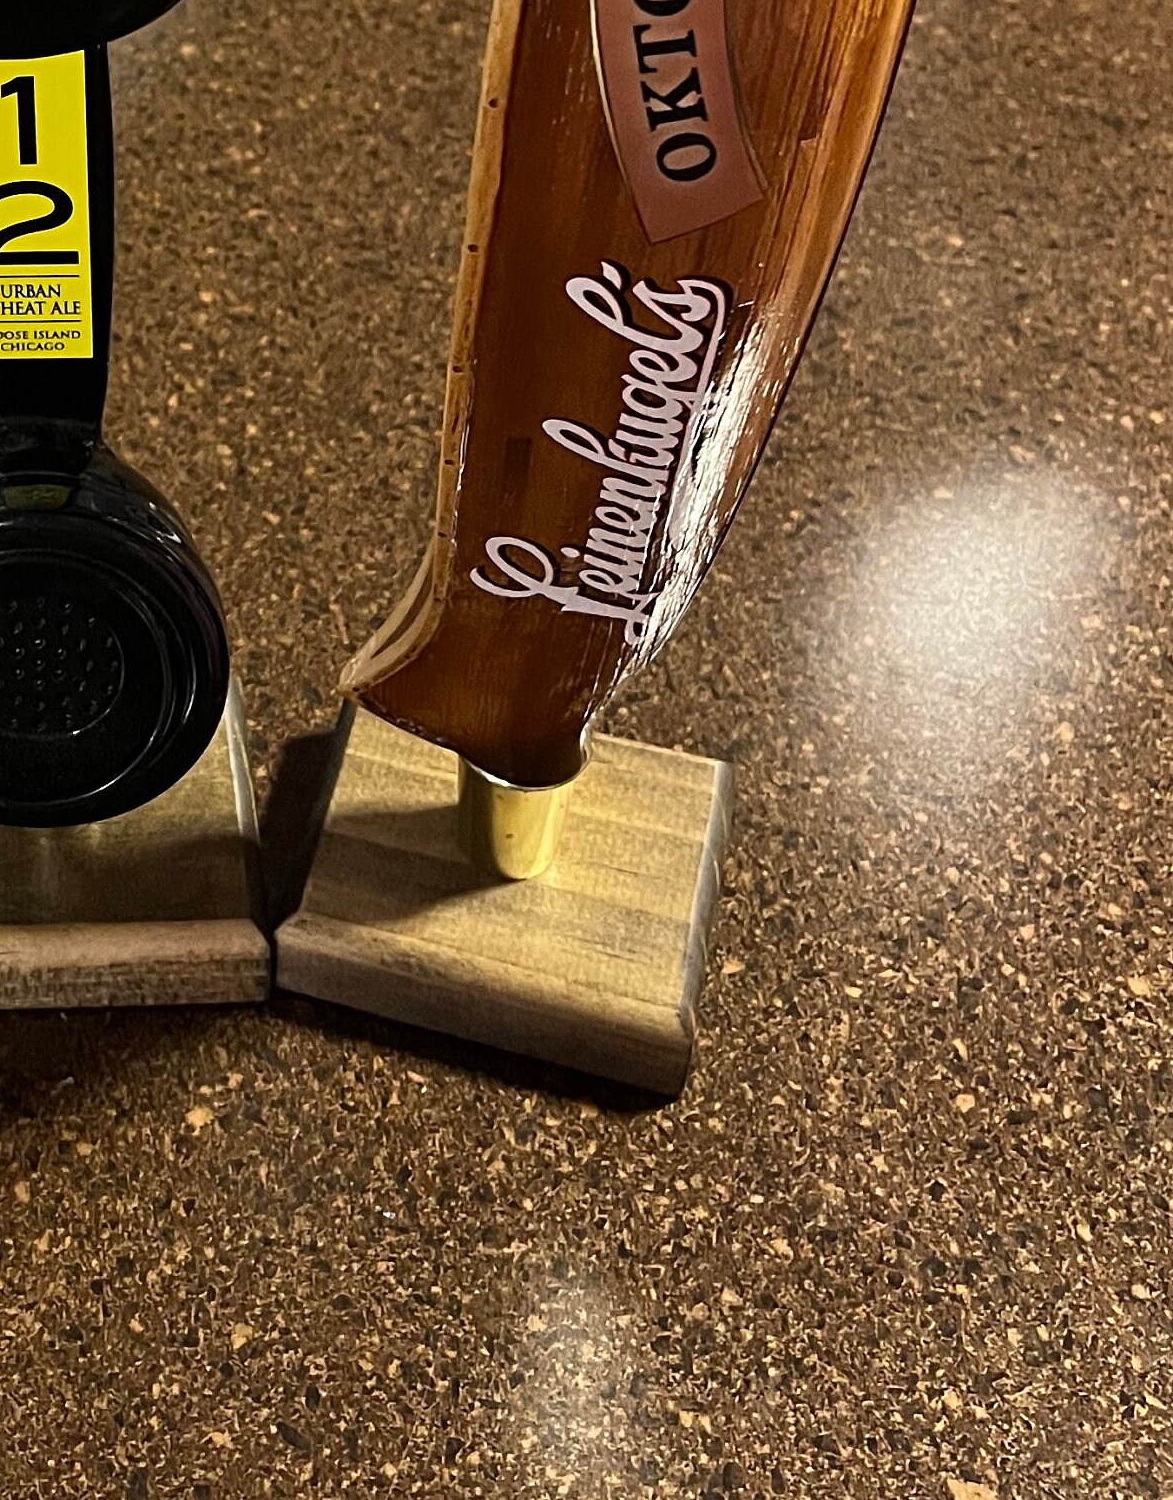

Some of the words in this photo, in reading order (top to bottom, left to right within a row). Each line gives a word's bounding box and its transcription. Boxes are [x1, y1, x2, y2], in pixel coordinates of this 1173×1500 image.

[0, 284, 61, 299] URBAN
[50, 301, 81, 315] ALE
[33, 330, 81, 340] ISLAND
[0, 342, 65, 351] CHICAGO
[469, 260, 726, 646] Leinenkugel's
